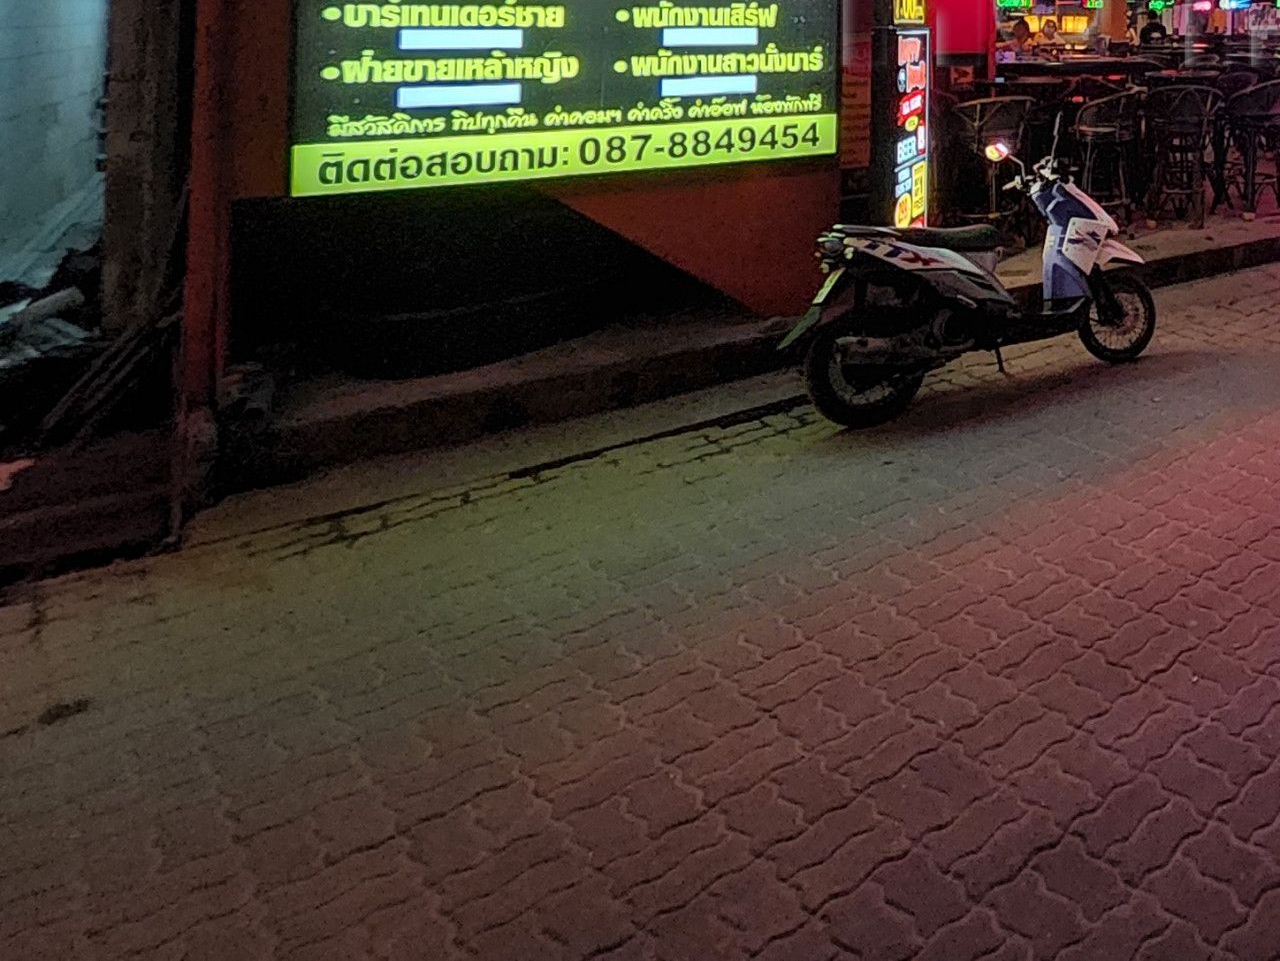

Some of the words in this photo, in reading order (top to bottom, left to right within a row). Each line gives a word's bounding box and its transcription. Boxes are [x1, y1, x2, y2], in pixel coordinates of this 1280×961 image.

[633, 0, 778, 28] พนักงานเสิร์ฟ
[341, 50, 579, 84] ฝ่ายขายเหล้าหญิง
[631, 43, 823, 76] พนักงานสาวนั่งบาร์
[318, 142, 569, 186] ติดต่อสอบถาม:
[579, 122, 820, 166] 087-8849454
